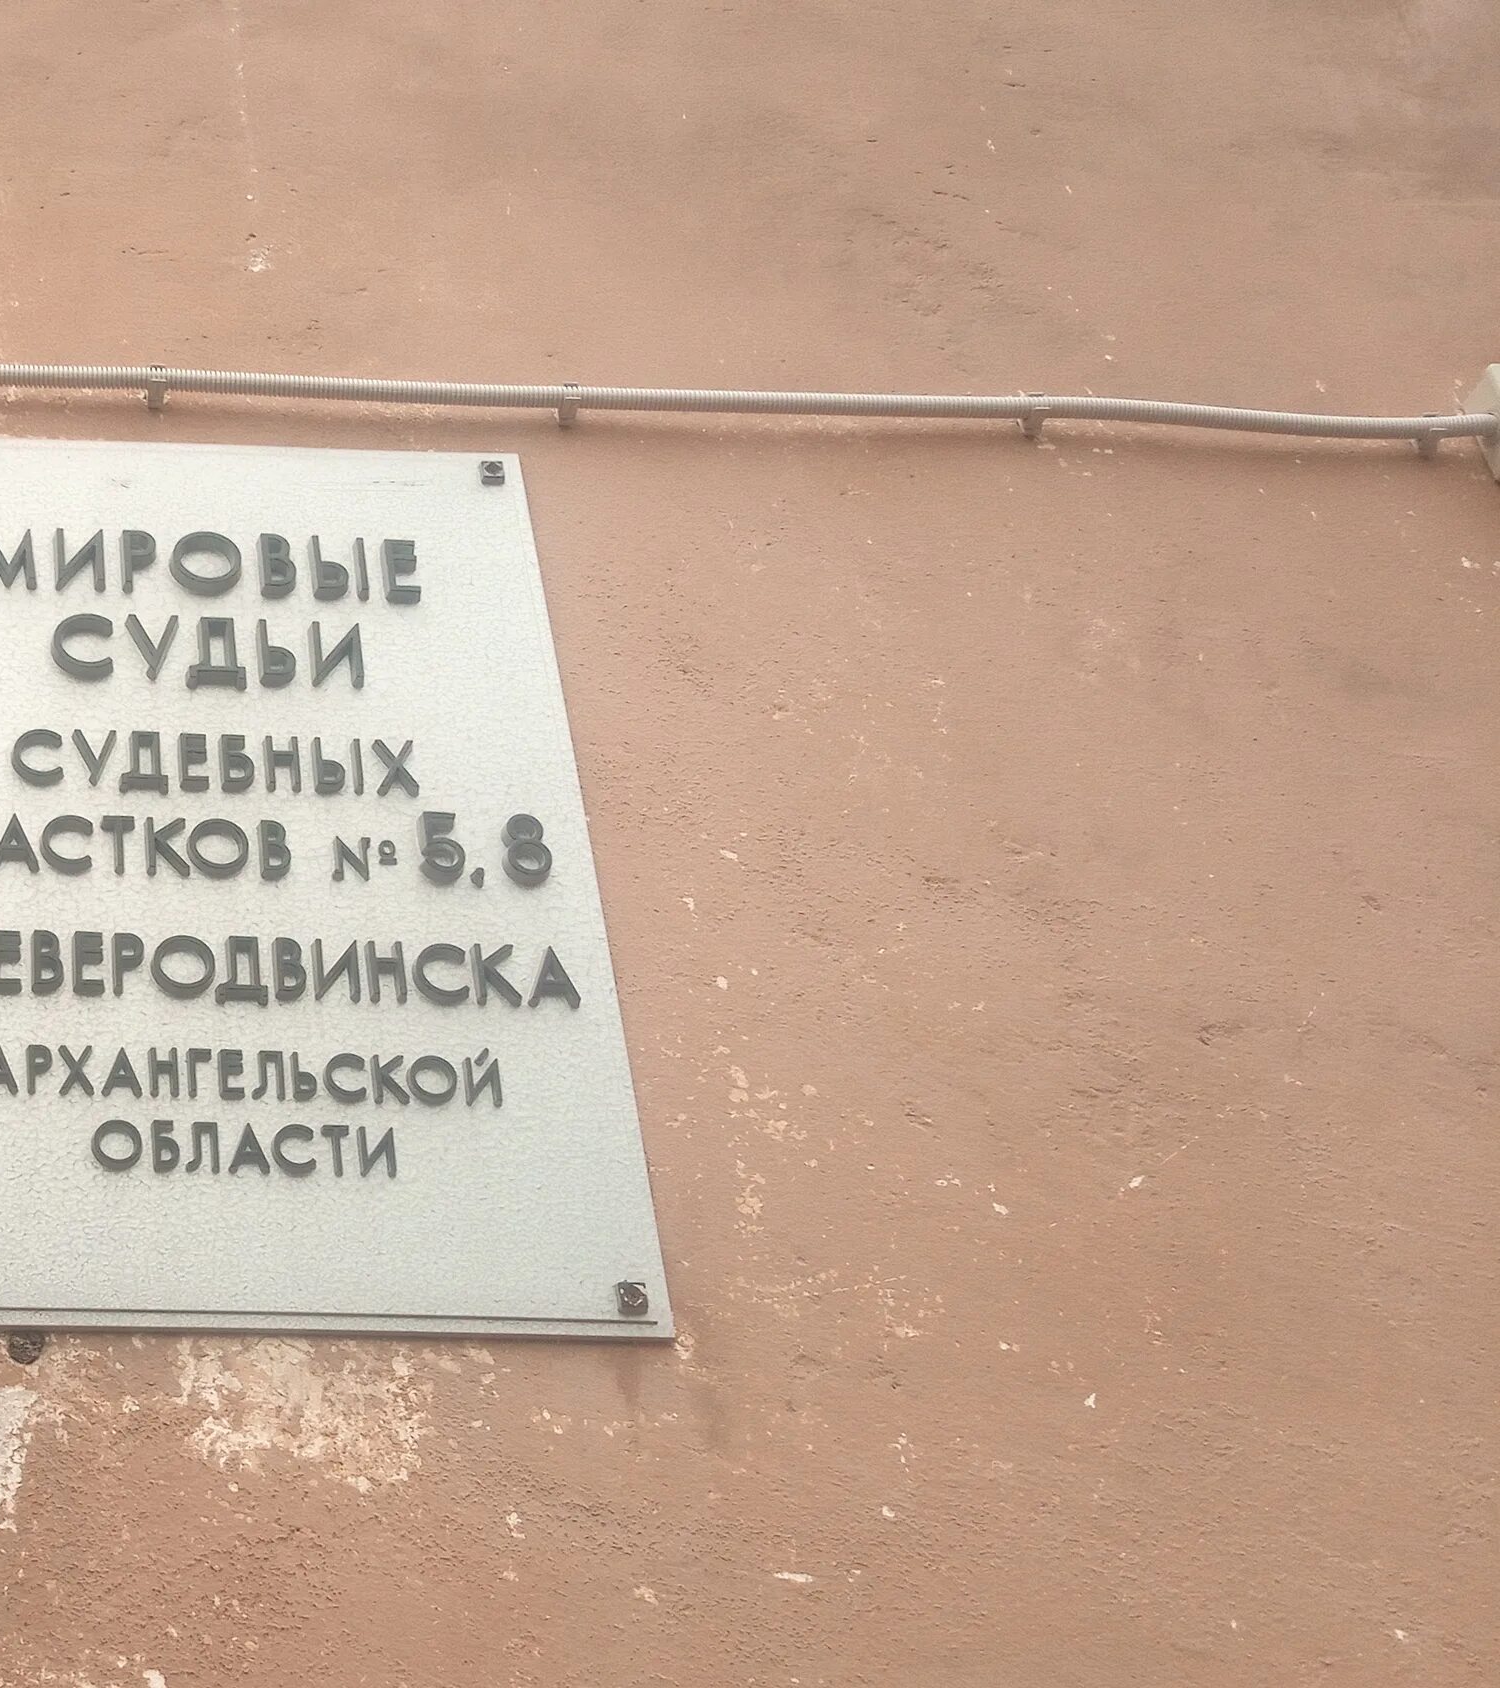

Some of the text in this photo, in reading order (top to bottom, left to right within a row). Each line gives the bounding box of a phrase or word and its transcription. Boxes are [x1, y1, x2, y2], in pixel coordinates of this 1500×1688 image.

[52, 612, 362, 693] СУДЬИ
[10, 727, 421, 798] СУДЕБНЫХ
[331, 834, 398, 883] №
[90, 1118, 398, 1179] ОБЛАСТИ
